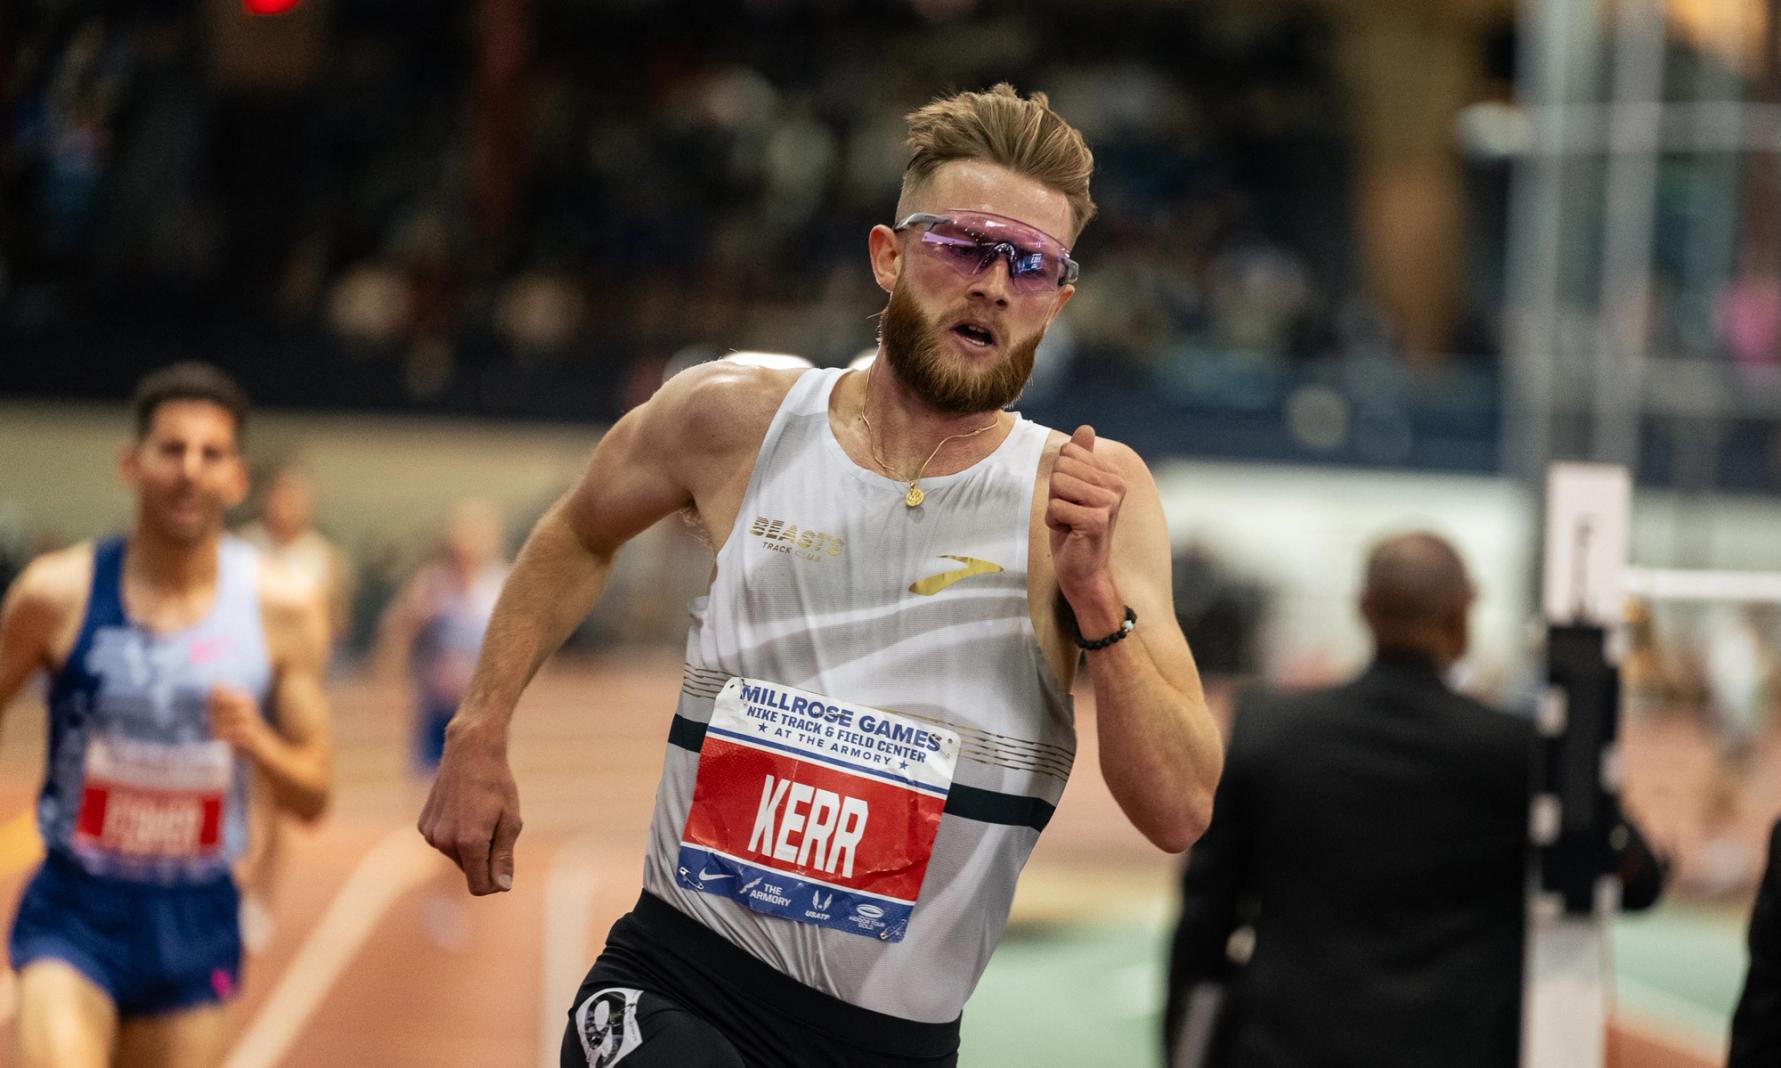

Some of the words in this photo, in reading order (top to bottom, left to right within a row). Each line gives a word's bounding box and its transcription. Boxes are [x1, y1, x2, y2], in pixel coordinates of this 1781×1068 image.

[749, 516, 844, 557] BEASTS
[762, 541, 793, 555] TRACK
[741, 686, 854, 727] MILLROSE
[858, 715, 941, 752] GAMES
[747, 706, 779, 723] NIKE
[781, 713, 823, 734] TRACK
[825, 726, 835, 738] &
[837, 729, 875, 749] FIELD
[877, 740, 927, 763] CENTER
[774, 727, 793, 739] AT
[799, 733, 825, 748] THE
[830, 742, 892, 766] ARMORY
[747, 774, 869, 879] KERR
[749, 889, 792, 907] ARMORY
[764, 883, 783, 896] THE
[805, 909, 831, 920] USATF
